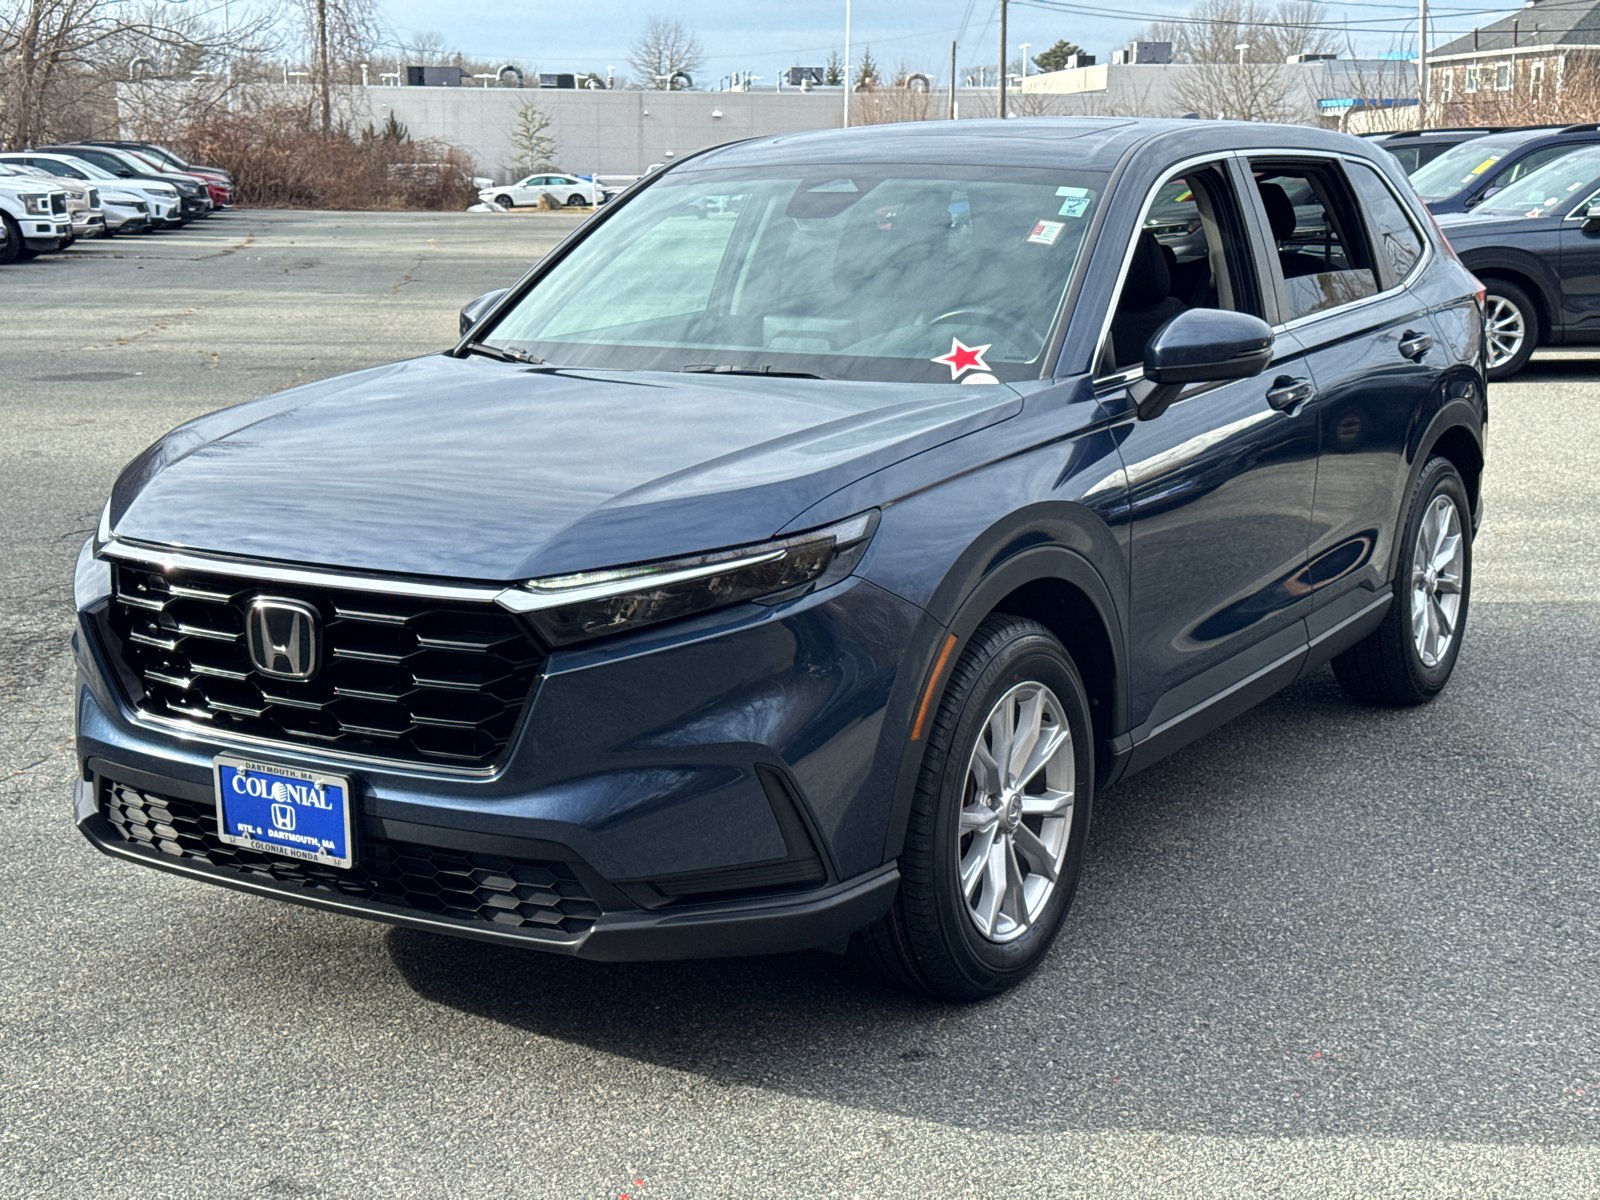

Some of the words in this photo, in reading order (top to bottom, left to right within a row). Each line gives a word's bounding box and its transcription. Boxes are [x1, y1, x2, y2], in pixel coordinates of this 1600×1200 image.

[300, 772, 313, 780] MA
[232, 775, 332, 810] COLONIAL
[237, 823, 256, 834] RTE.
[256, 827, 263, 835] 6
[267, 829, 321, 847] DARTMOUTH,
[321, 839, 336, 850] MA
[250, 841, 288, 855] COLONIAL
[290, 849, 319, 861] HONDA
